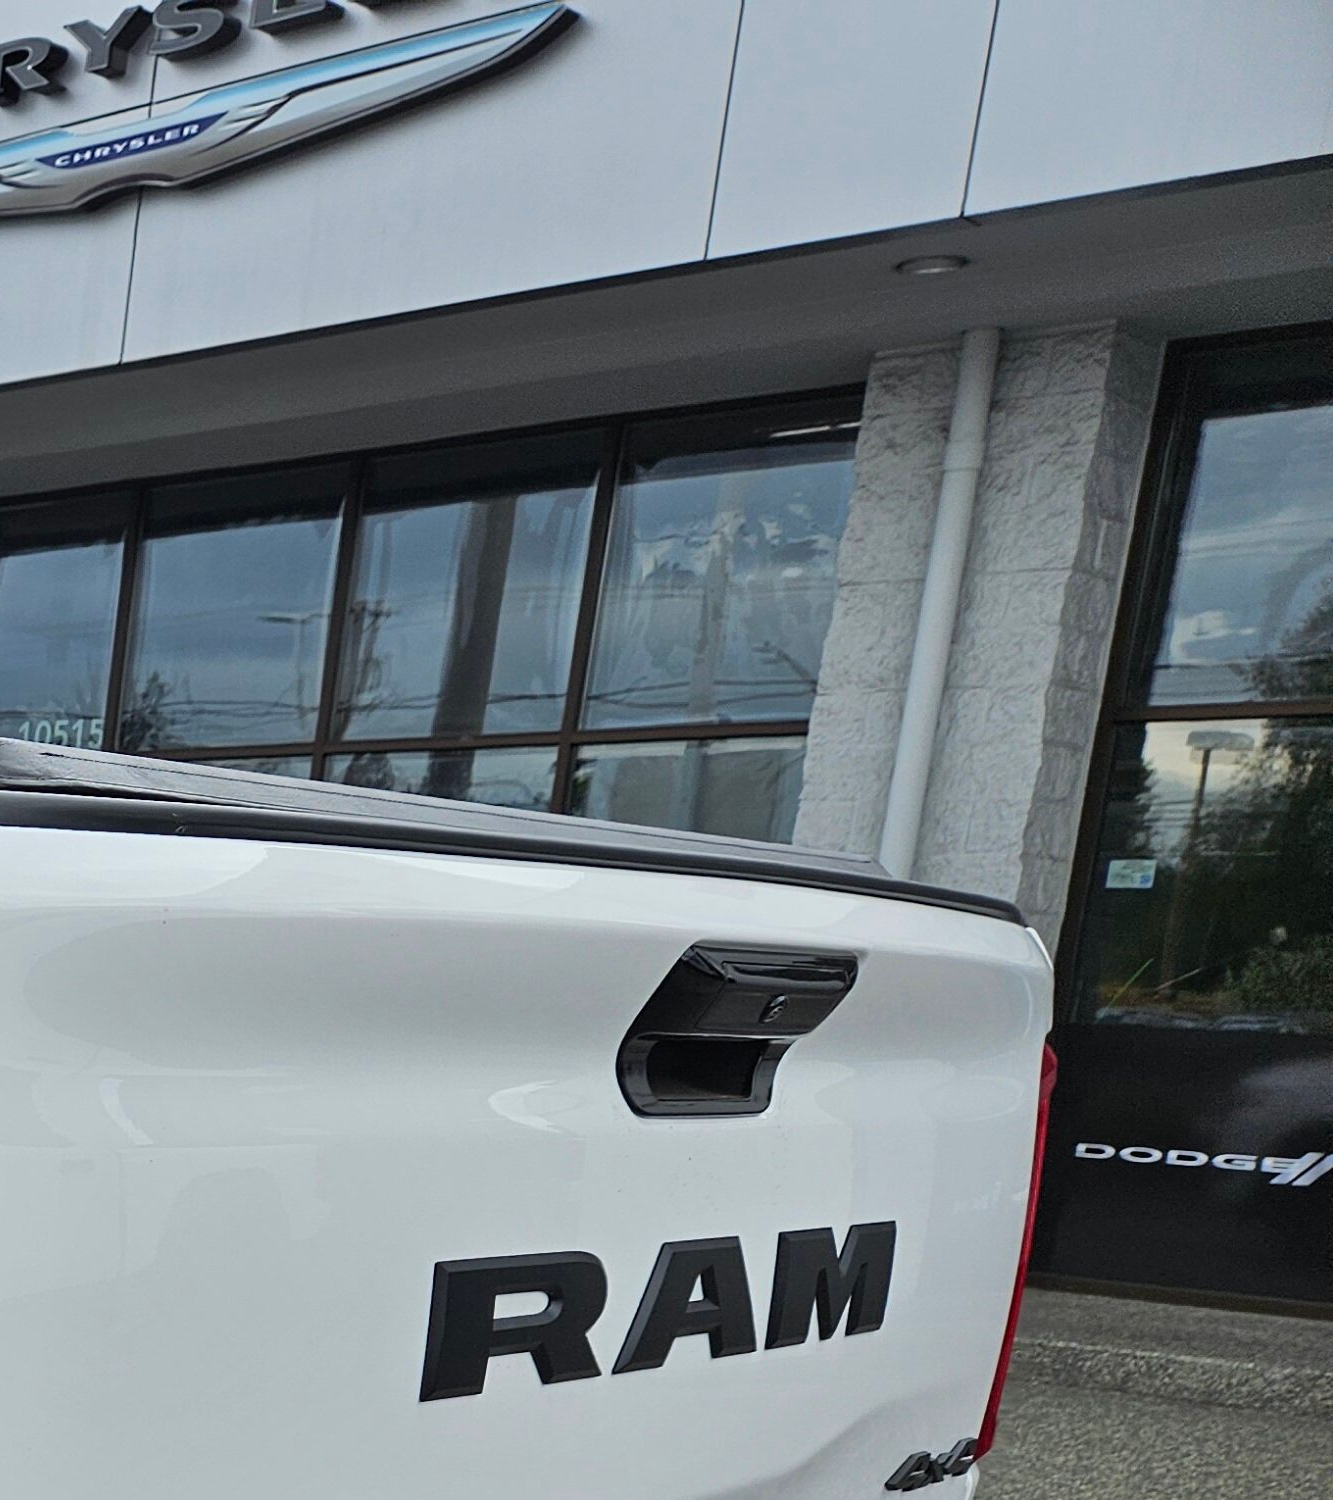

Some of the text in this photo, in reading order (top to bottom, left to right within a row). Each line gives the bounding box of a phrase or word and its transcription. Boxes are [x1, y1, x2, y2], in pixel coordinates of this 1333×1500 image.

[54, 123, 200, 168] CHRYSLER
[19, 718, 104, 750] 10515
[1075, 1142, 1301, 1174] DODGE
[418, 1220, 897, 1402] RAM
